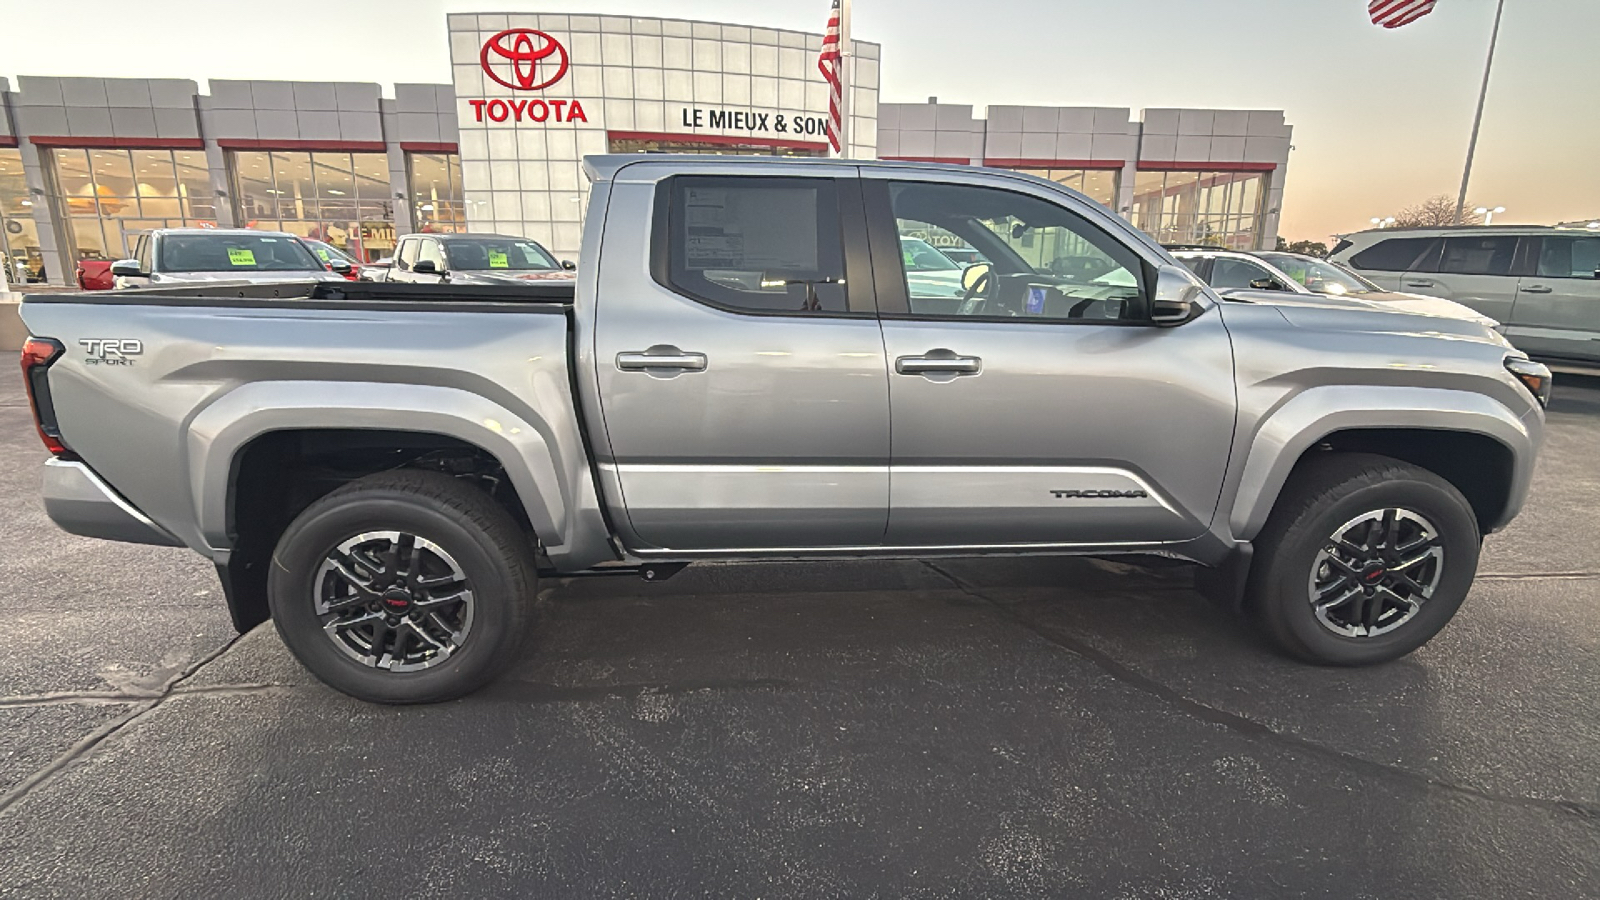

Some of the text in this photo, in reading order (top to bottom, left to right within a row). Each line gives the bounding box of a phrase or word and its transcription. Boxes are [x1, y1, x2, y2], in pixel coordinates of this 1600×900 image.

[468, 99, 588, 122] TOYOTA
[683, 108, 703, 127] LE
[709, 110, 769, 131] MIEUX
[774, 115, 787, 133] &
[79, 338, 143, 359] TRD
[1050, 489, 1148, 498] TACOMA
